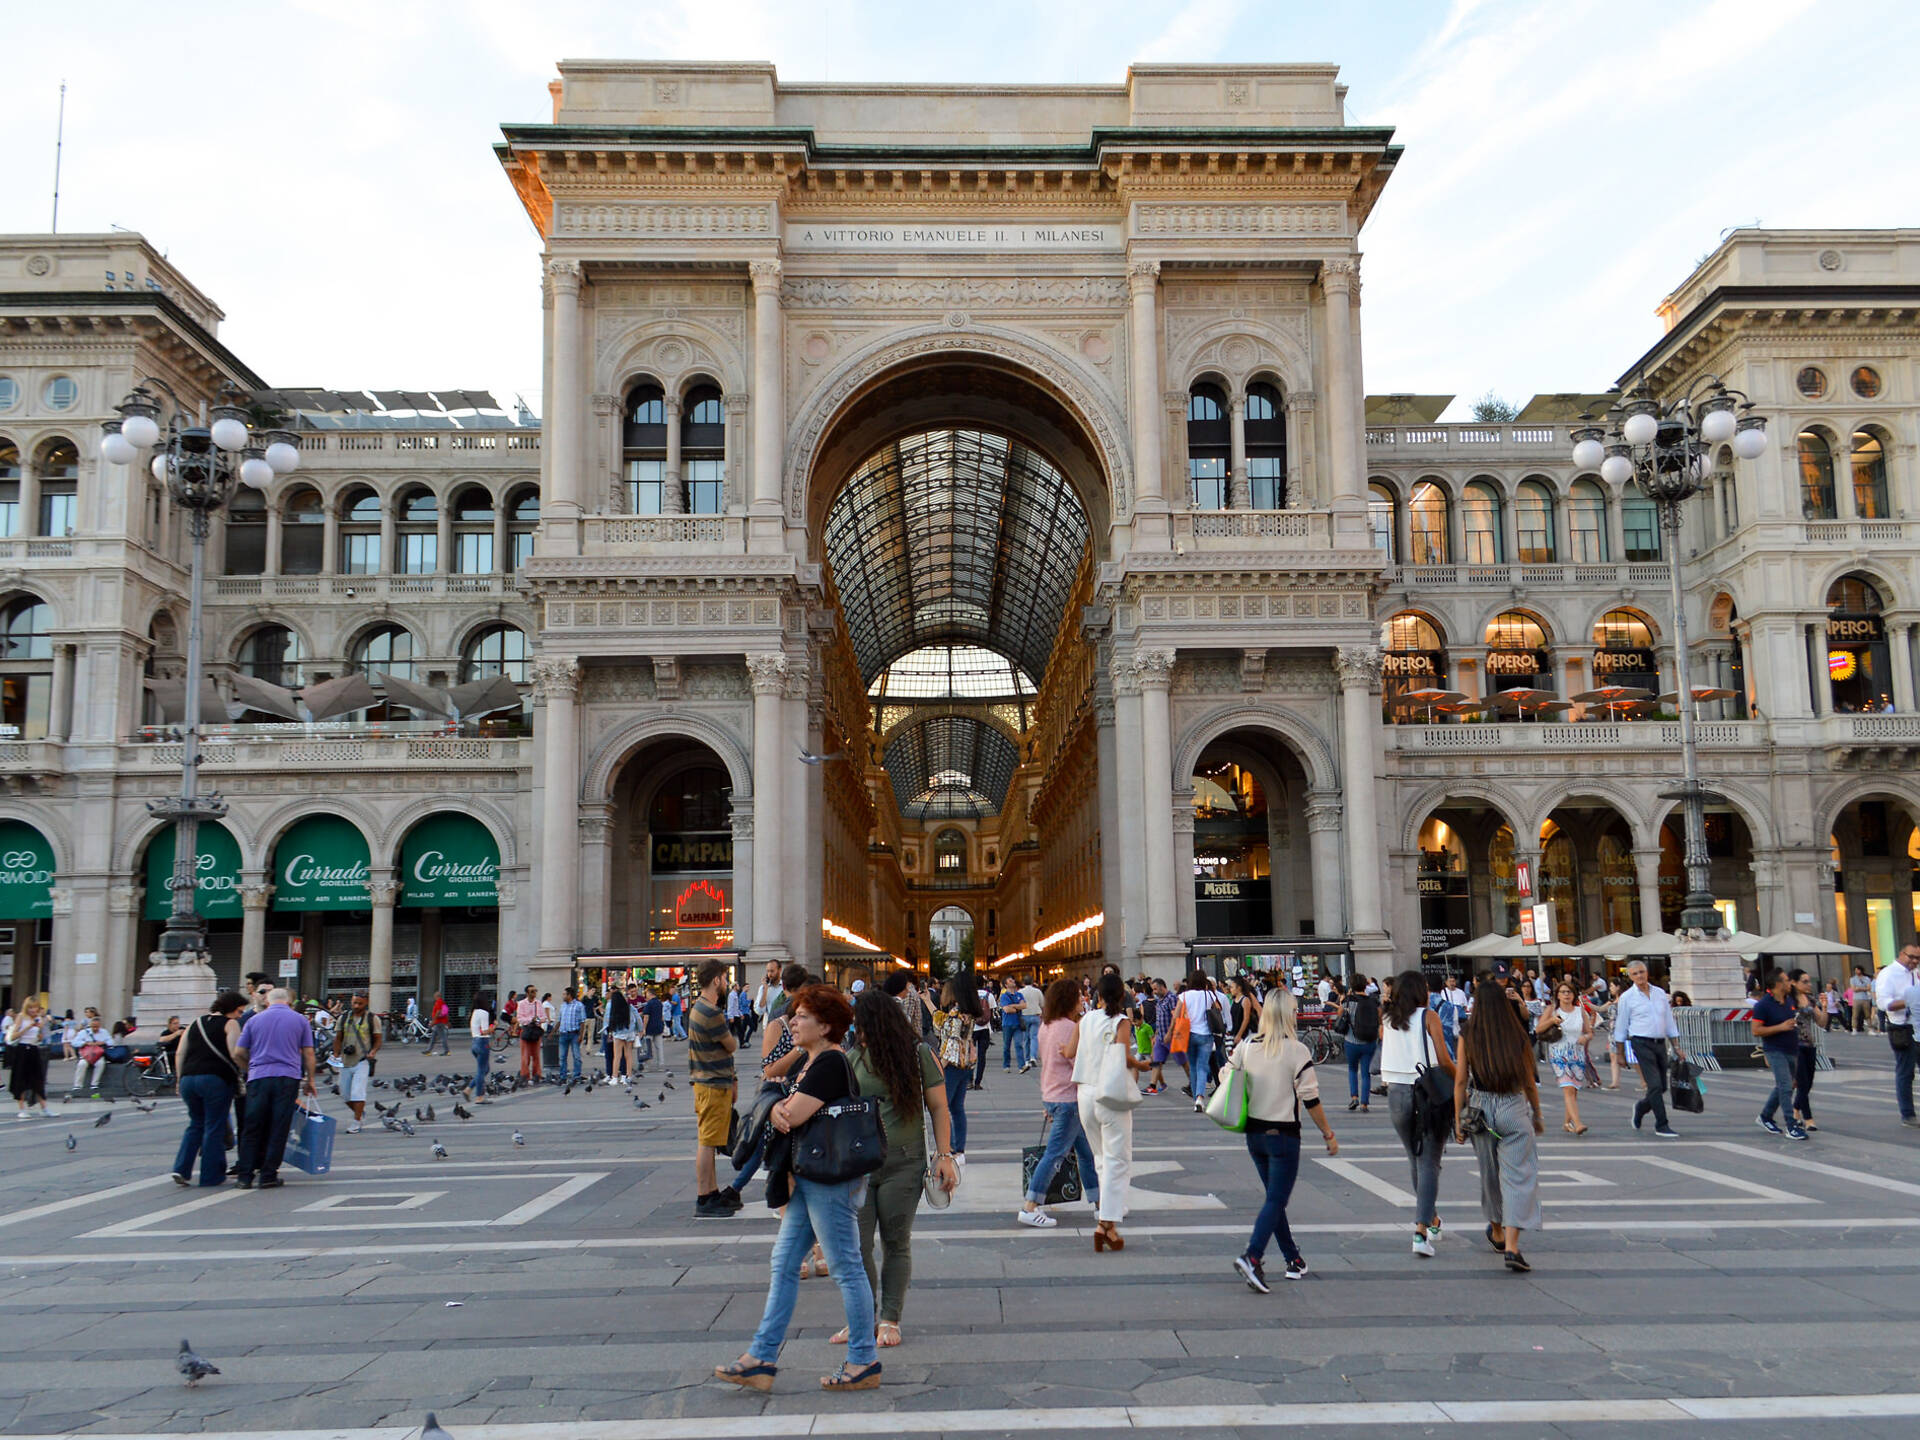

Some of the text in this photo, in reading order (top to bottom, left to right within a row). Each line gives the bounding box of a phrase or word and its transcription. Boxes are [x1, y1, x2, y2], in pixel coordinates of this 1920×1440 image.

[804, 230, 814, 241] A
[823, 230, 894, 241] VITTORIO
[903, 230, 986, 241] EMANUELE
[1035, 230, 1104, 241] MILANESI
[1382, 654, 1434, 671] APEROL
[1487, 652, 1539, 668] APEROL
[1593, 651, 1646, 667] APEROL
[284, 854, 368, 887] Currado
[414, 850, 496, 883] Currado
[448, 875, 494, 883] GIOIELLERIE
[1517, 867, 1530, 891] M
[1603, 876, 1634, 886] FOOD
[1204, 883, 1240, 895] Motta
[681, 911, 721, 923] CAMPARI
